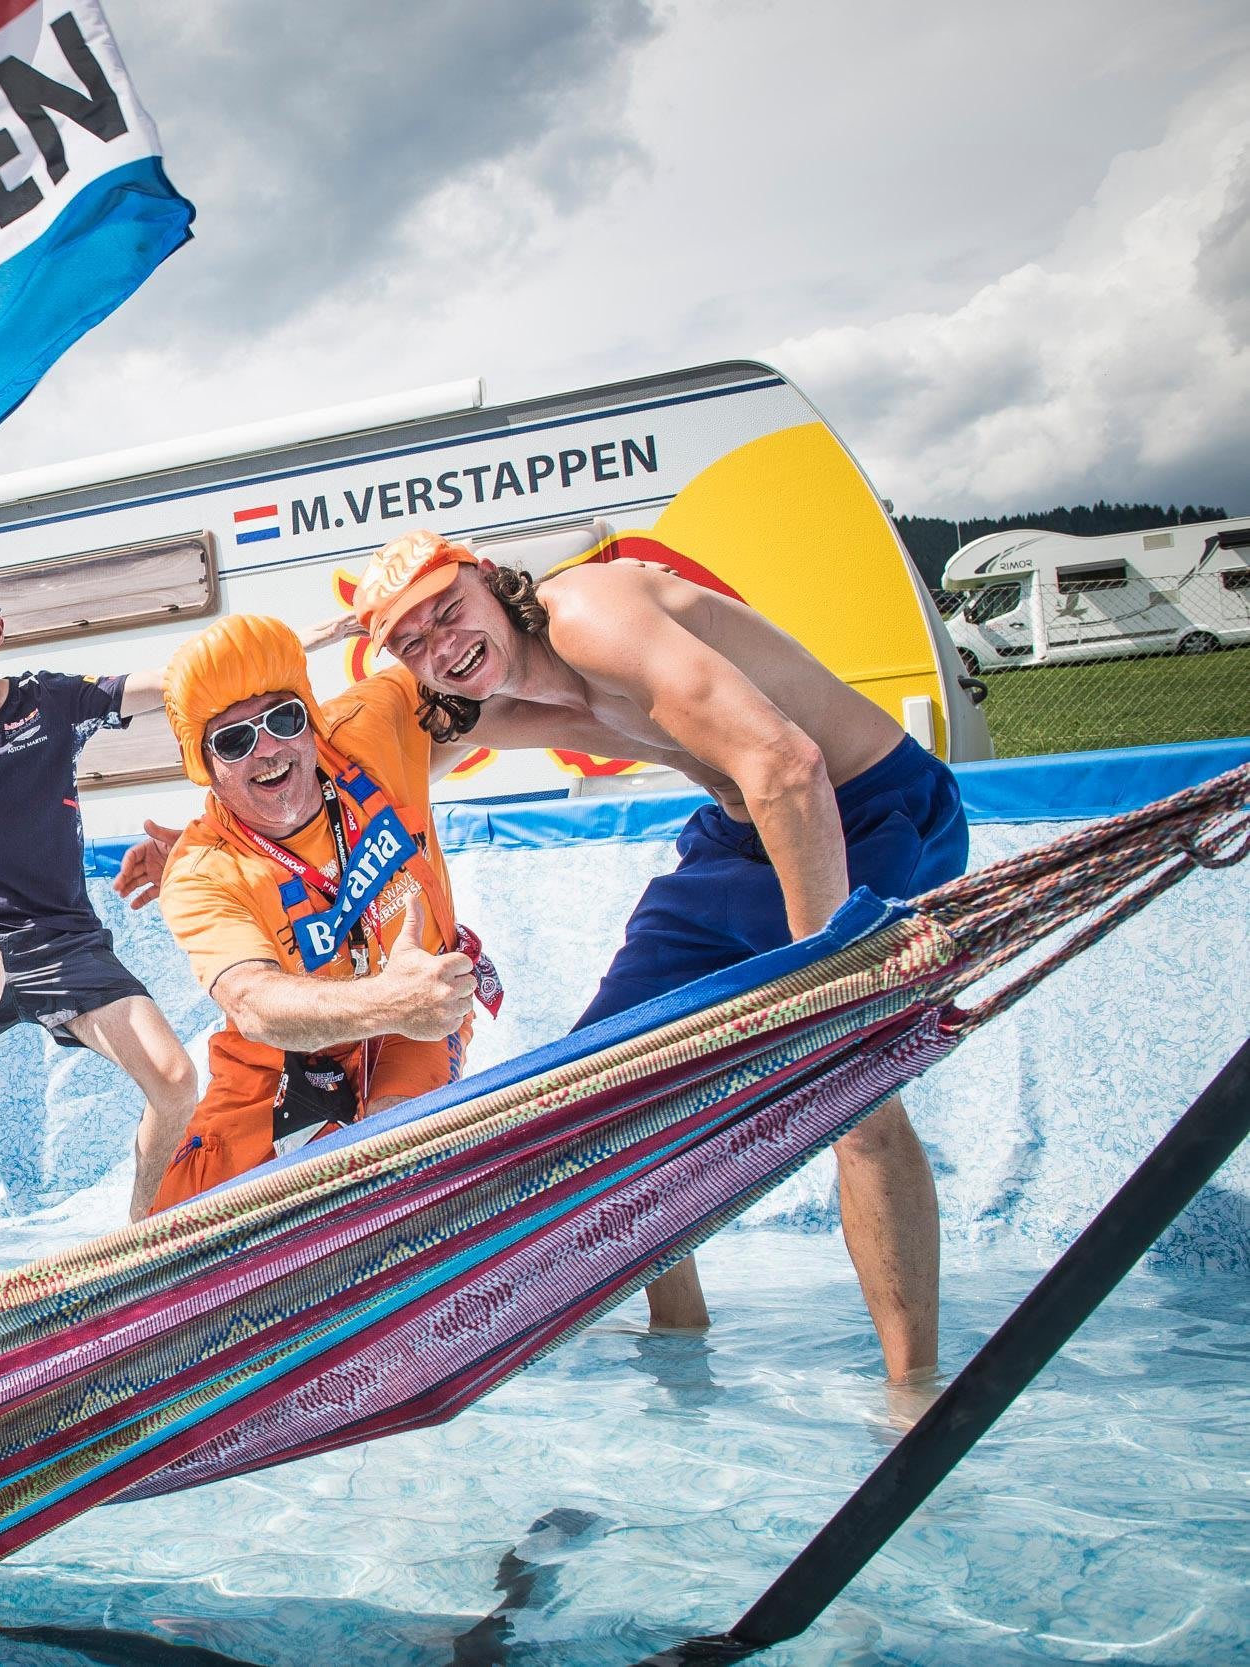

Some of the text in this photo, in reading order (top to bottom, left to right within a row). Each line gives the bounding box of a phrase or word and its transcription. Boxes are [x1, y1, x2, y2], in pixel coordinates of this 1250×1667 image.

[291, 435, 658, 535] M.VERSTAPPEN
[999, 559, 1032, 571] RIMOR
[306, 829, 403, 956] Baria
